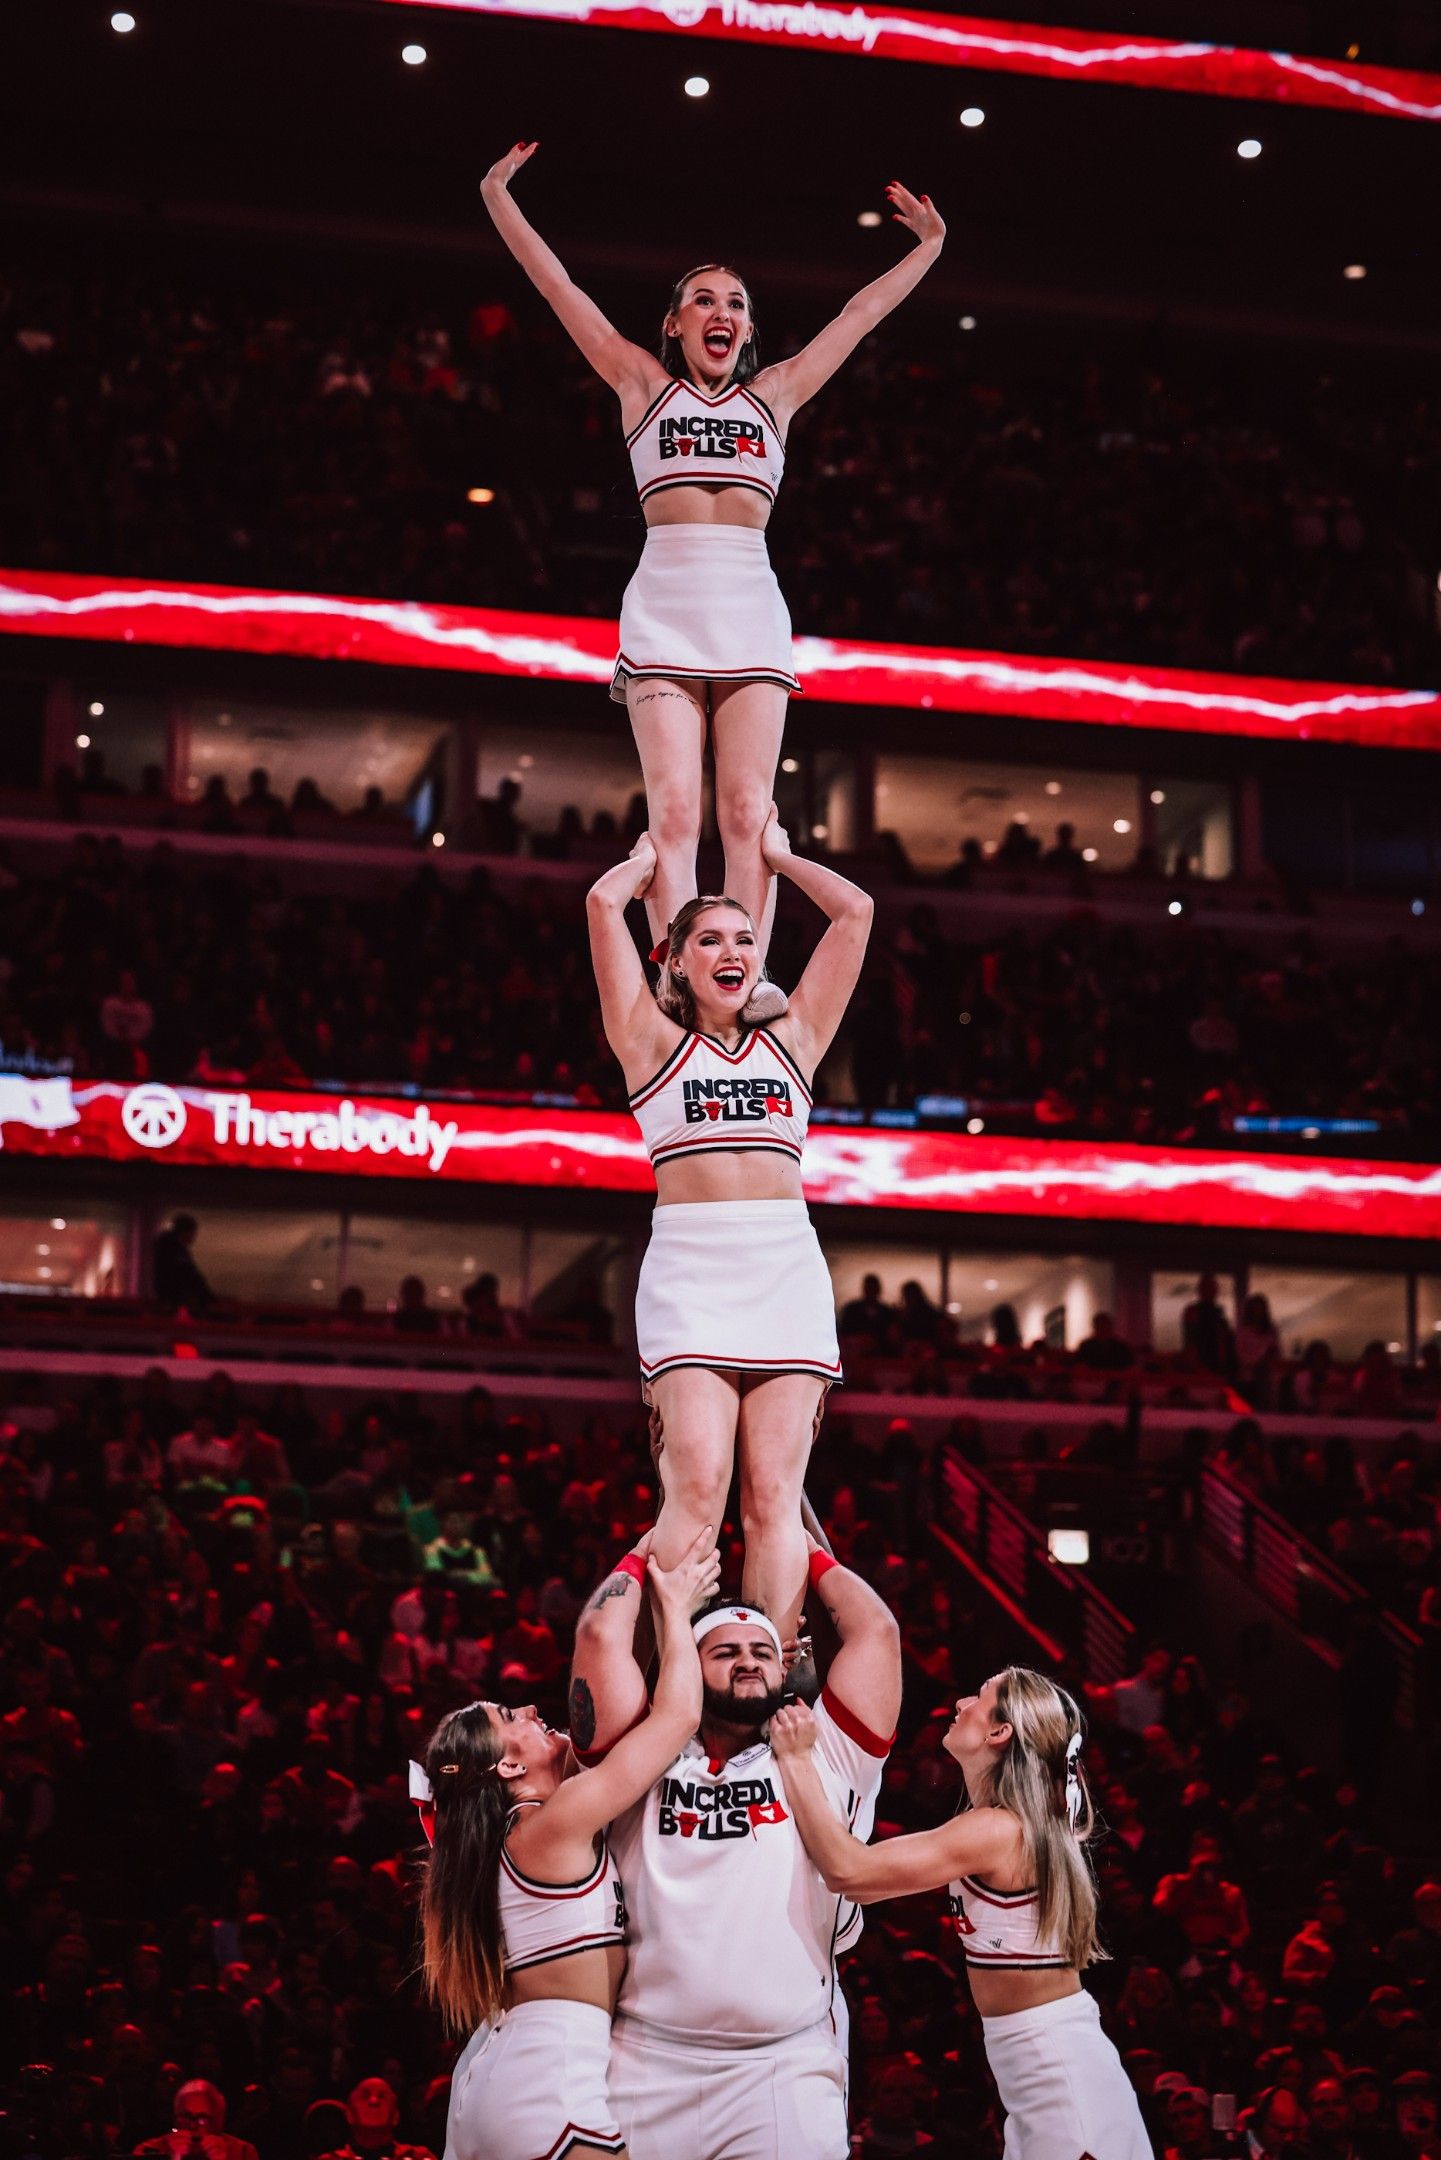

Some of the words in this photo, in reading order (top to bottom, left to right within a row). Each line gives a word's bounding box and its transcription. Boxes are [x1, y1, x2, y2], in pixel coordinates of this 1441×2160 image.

[659, 416, 764, 442] INCREDI
[683, 1079, 792, 1102] INCREDI
[205, 1093, 458, 1172] Therabody
[660, 1777, 777, 1815] INCREDI
